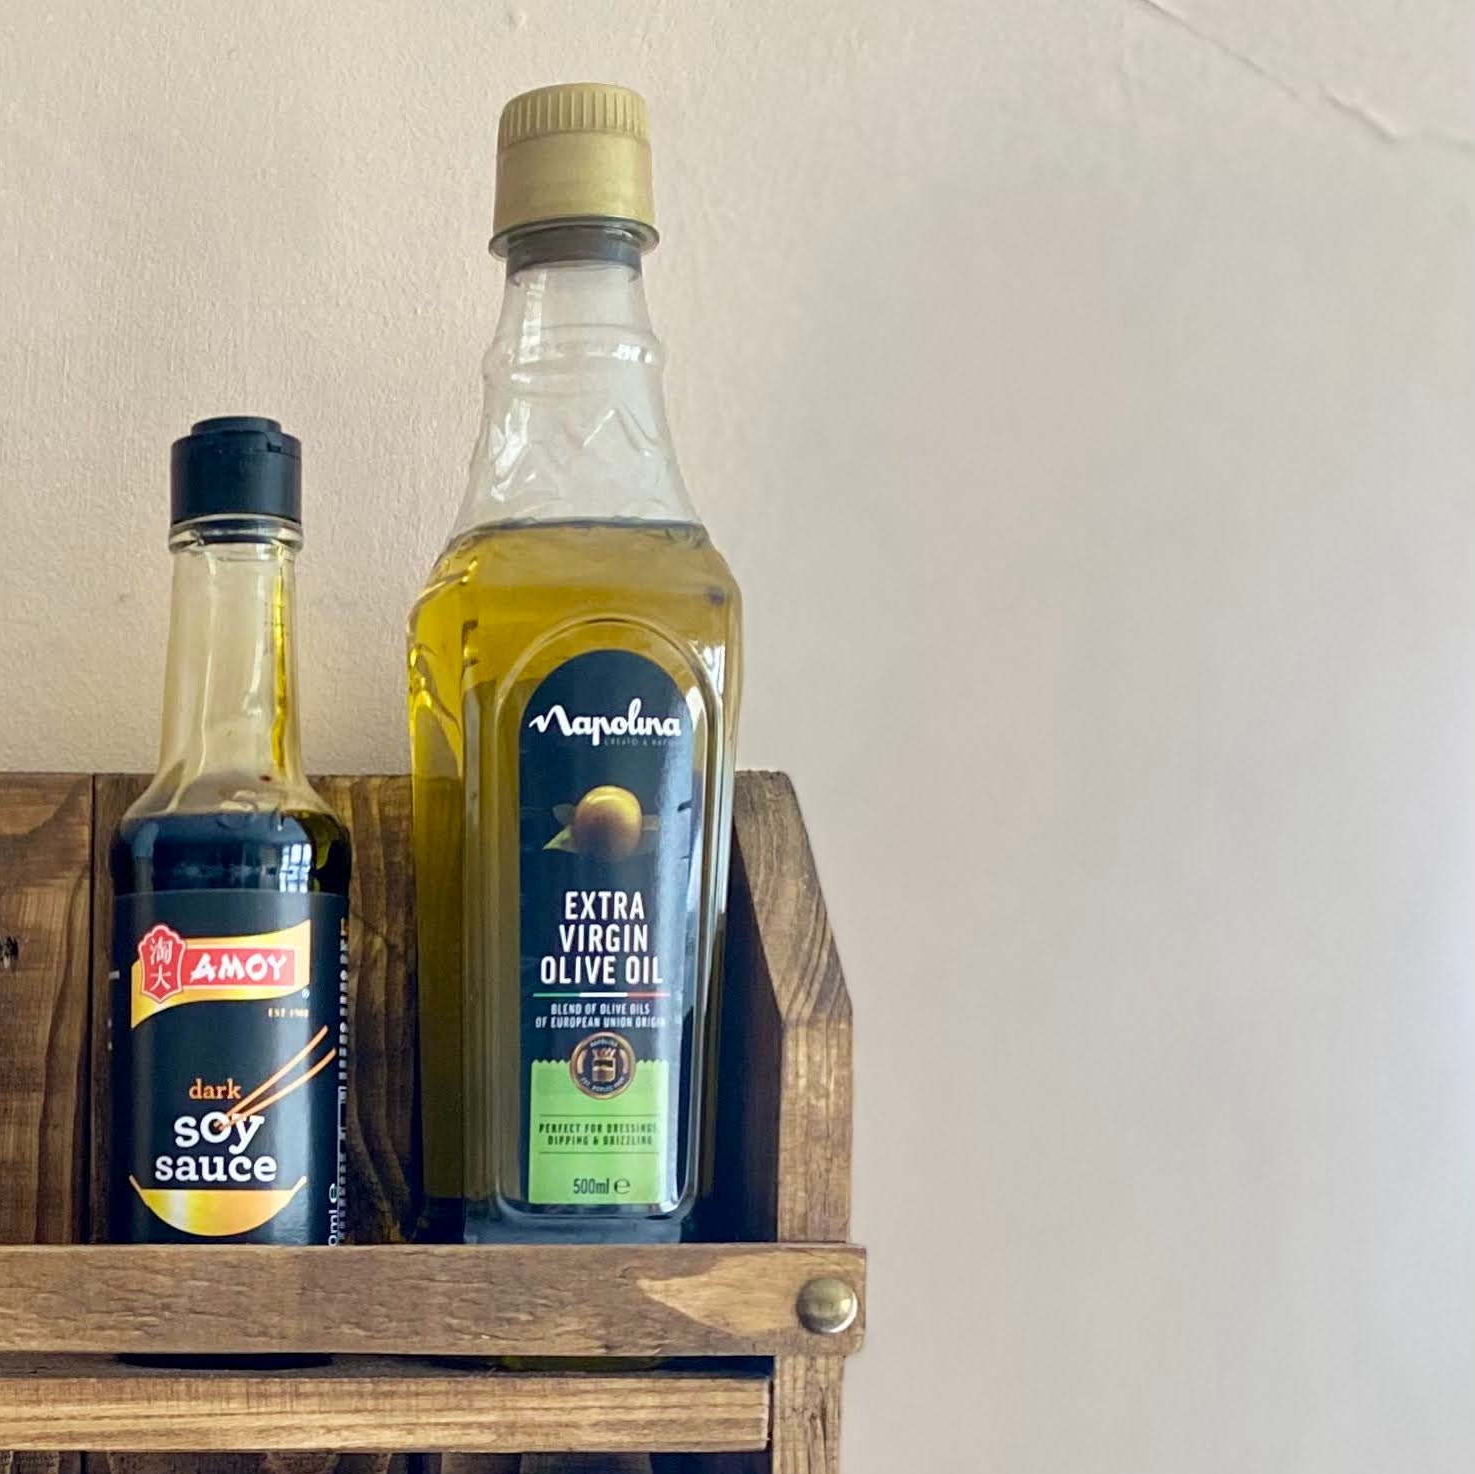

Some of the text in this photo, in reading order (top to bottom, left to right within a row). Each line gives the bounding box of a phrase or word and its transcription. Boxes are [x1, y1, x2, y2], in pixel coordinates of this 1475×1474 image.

[529, 698, 681, 746] Napolina
[565, 891, 645, 920] EXTRA
[559, 924, 648, 952] VIRGIN
[190, 953, 287, 982] AMOY
[540, 956, 663, 984] OLIVE OIL
[535, 1016, 548, 1028] OF
[550, 1016, 601, 1028] EUROPEAN
[603, 1016, 633, 1028] UNION
[551, 1003, 650, 1015] BLEND OF OLIVE OILS
[189, 1078, 241, 1101] dark
[174, 1112, 264, 1154] soy
[539, 1124, 581, 1133] PERFECT
[584, 1124, 603, 1133] FOR
[547, 1136, 588, 1145] DIPPING
[155, 1155, 277, 1181] sauce
[573, 1178, 610, 1194] 500ml
